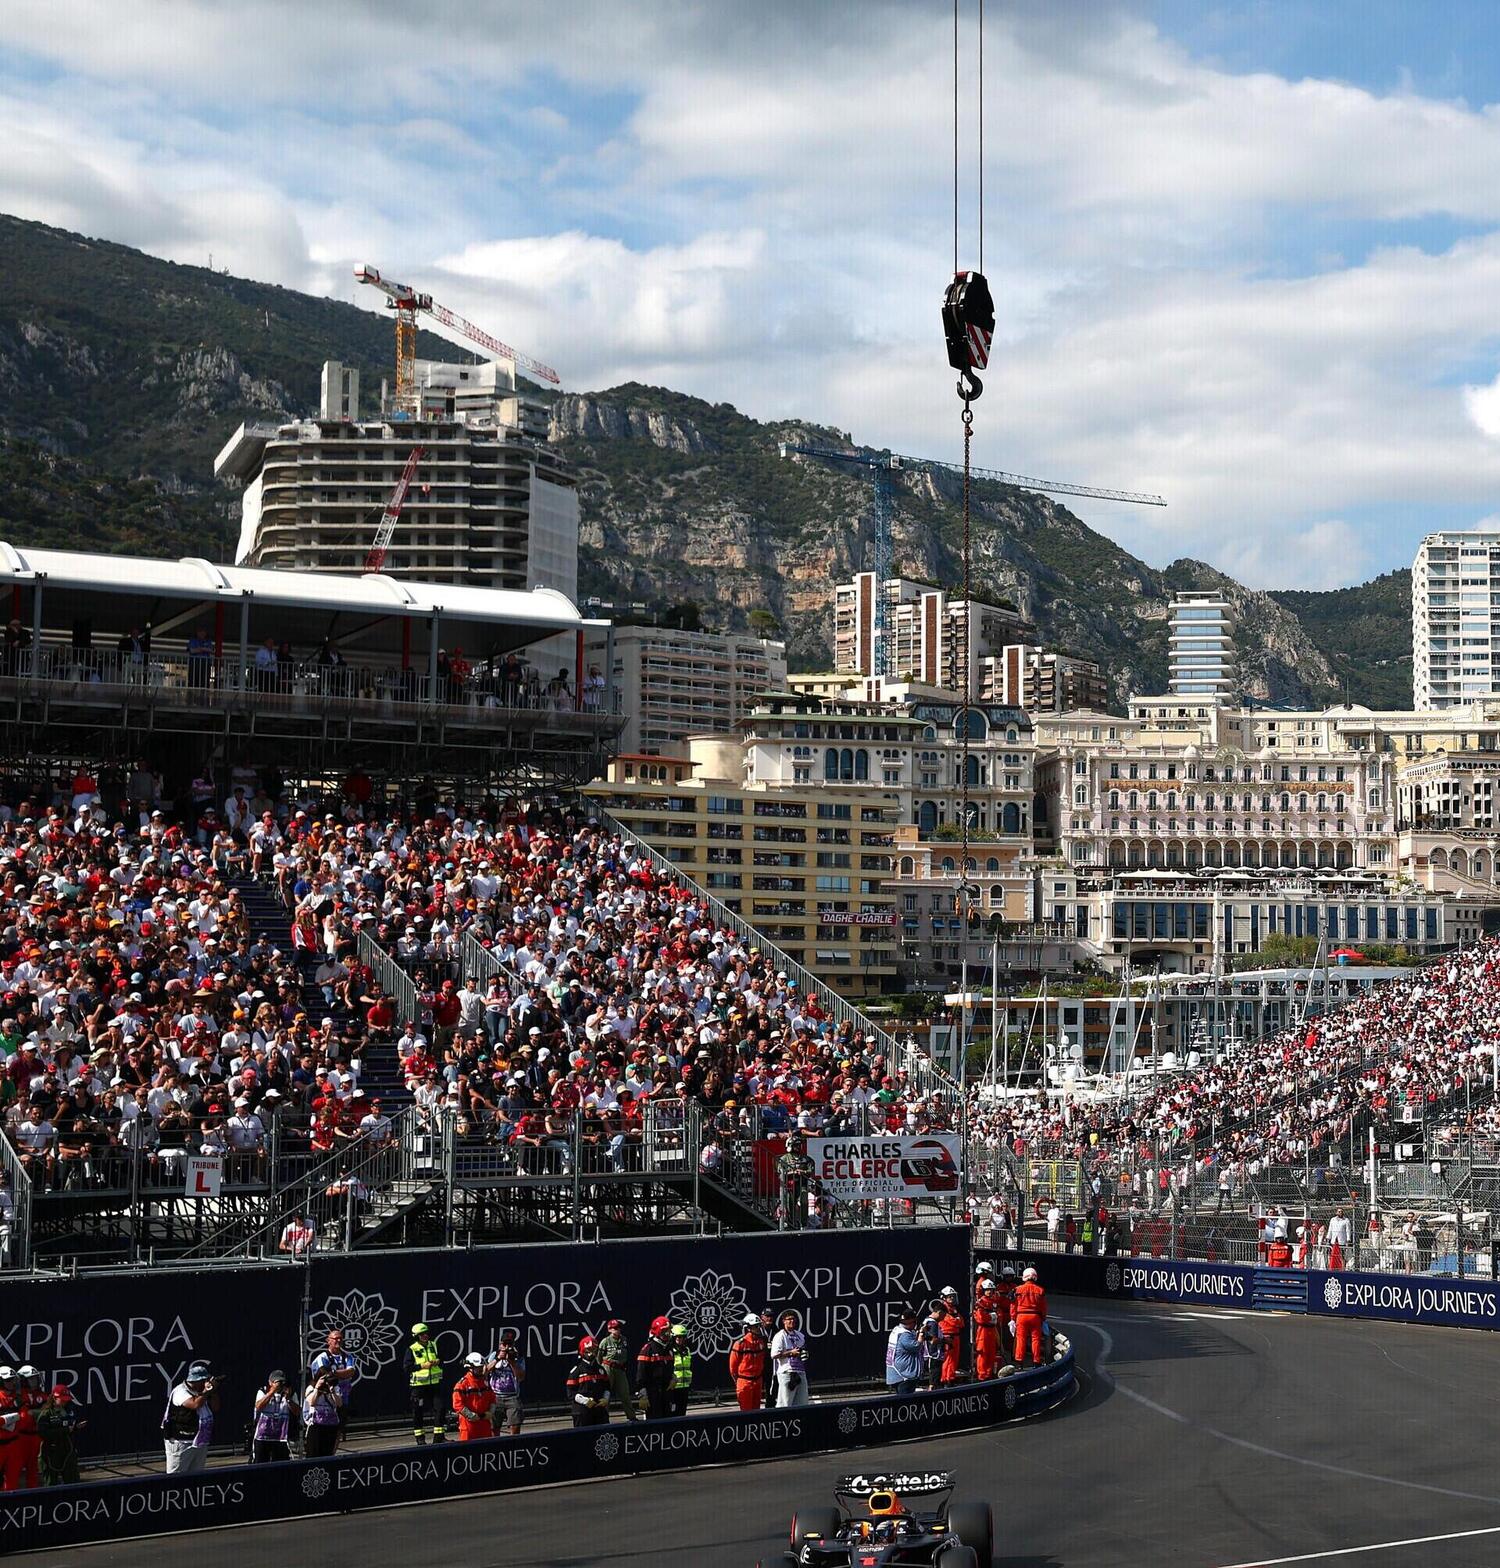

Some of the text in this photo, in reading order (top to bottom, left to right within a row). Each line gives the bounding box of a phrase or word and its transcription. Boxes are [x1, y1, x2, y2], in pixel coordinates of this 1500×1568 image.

[192, 1161, 219, 1169] TRIBUNE
[823, 1143, 902, 1160] CHARLES
[195, 1171, 211, 1193] L
[767, 1262, 932, 1301] EXPLORA
[1123, 1268, 1244, 1297] EXPLORA JOURNEYS
[1345, 1283, 1497, 1316] EXPLORA JOURNEYS
[422, 1280, 613, 1322] EXPLORA
[775, 1298, 944, 1338] OURNEY
[0, 1315, 194, 1362] XPLORA
[434, 1319, 627, 1364] OURNEY
[861, 1393, 990, 1427] EXPLORA JOURNEYS
[624, 1419, 801, 1454] EXPLORA JOURNEYS
[337, 1446, 549, 1490] EXPLORA JOURNEYS
[0, 1482, 245, 1532] XPLORA JOURNEYS
